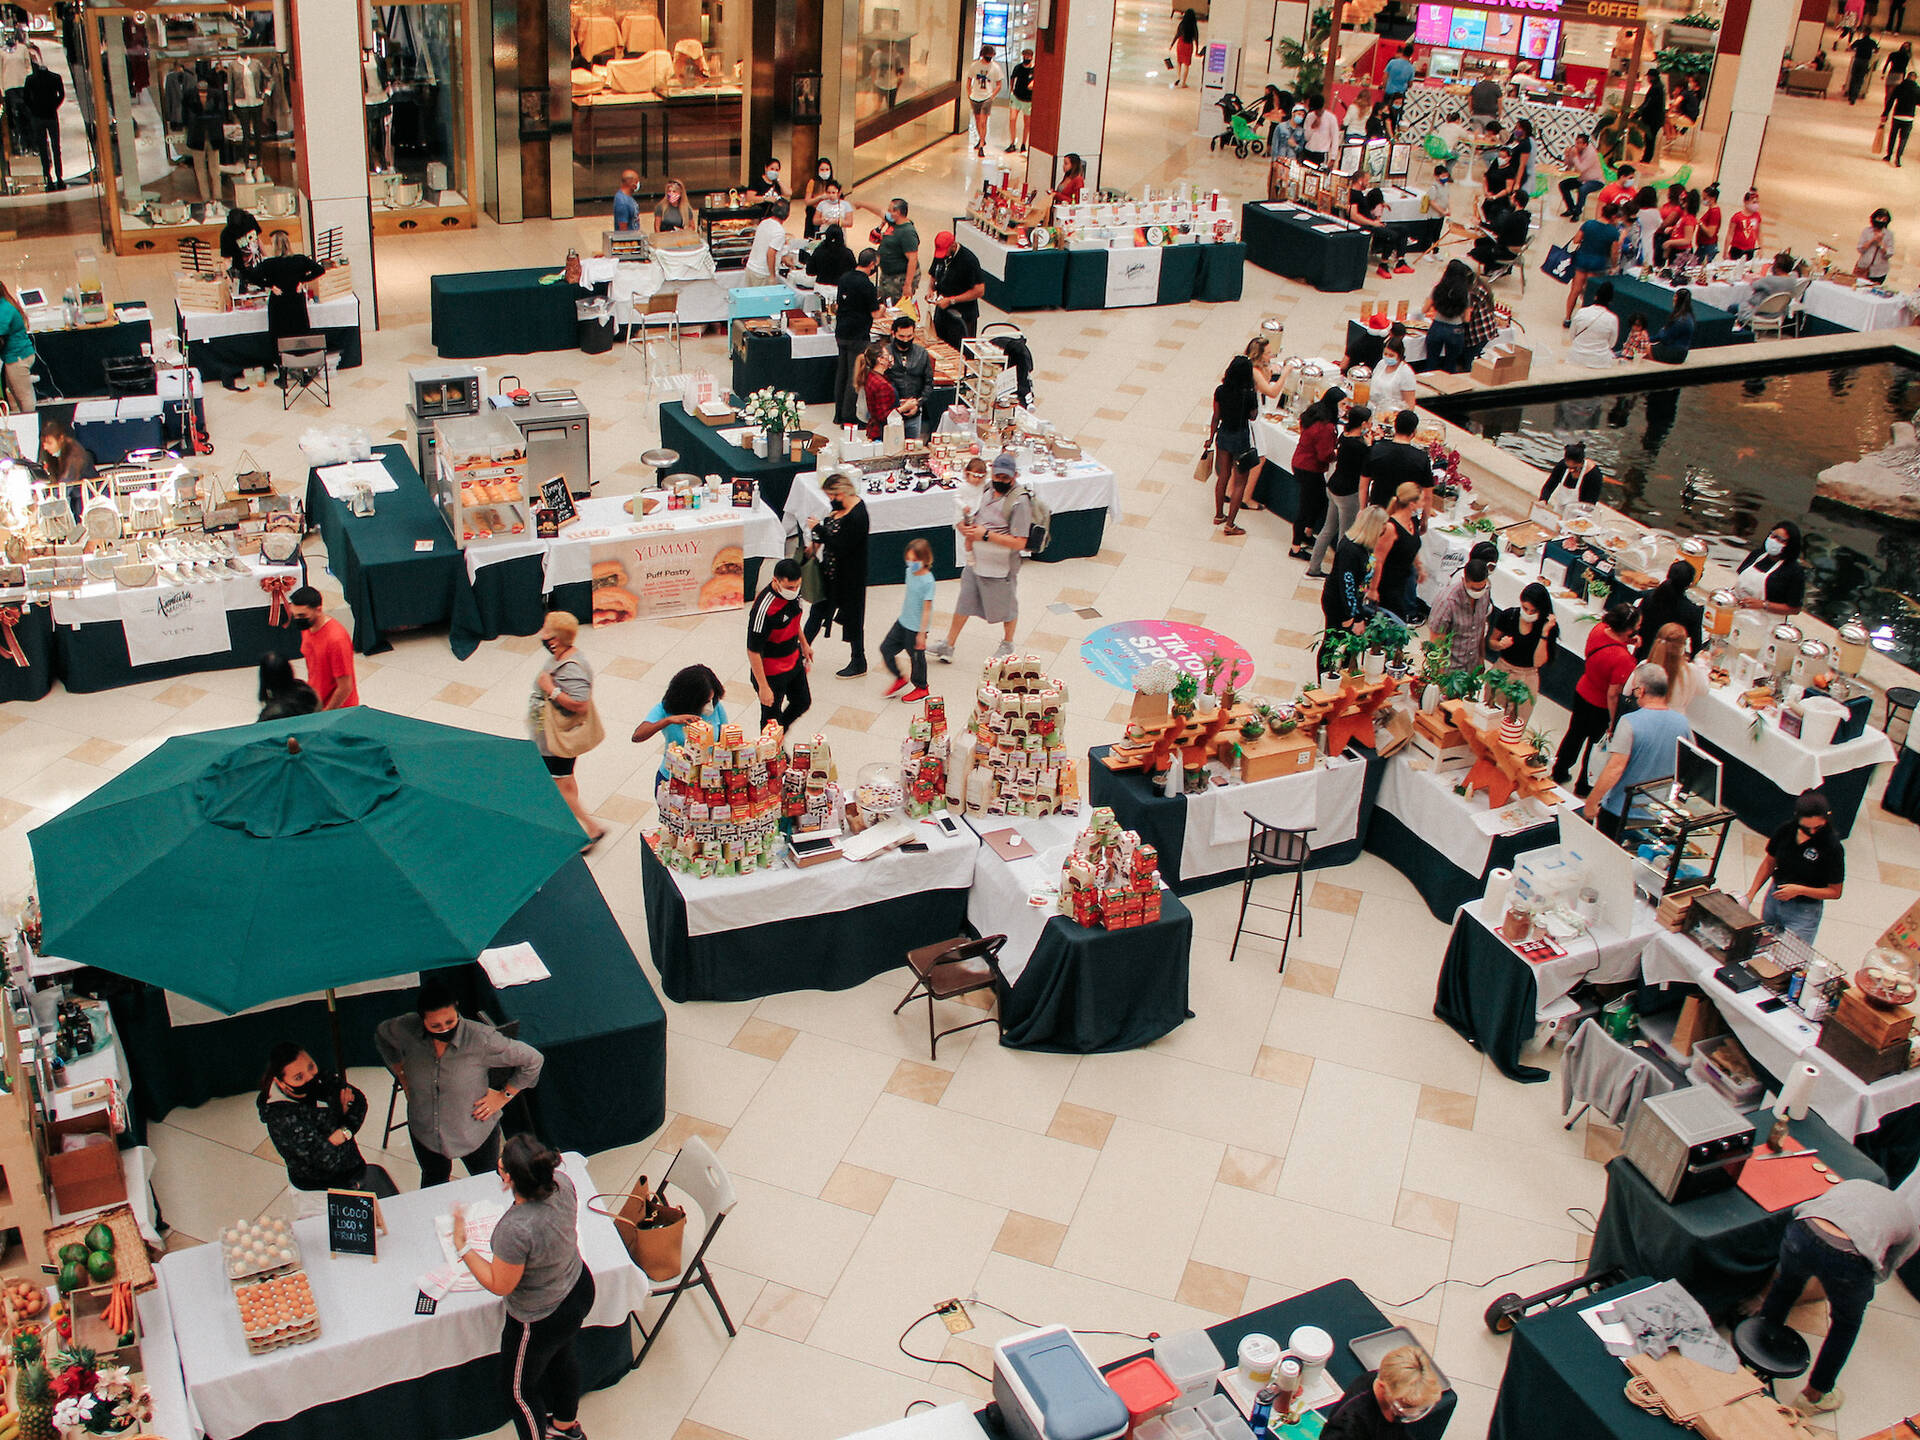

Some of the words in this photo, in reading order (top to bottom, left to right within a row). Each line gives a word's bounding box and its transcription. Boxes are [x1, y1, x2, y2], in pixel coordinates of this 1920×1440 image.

[634, 540, 701, 561] YUMMY
[646, 571, 663, 580] Puff
[665, 568, 691, 578] Pastry
